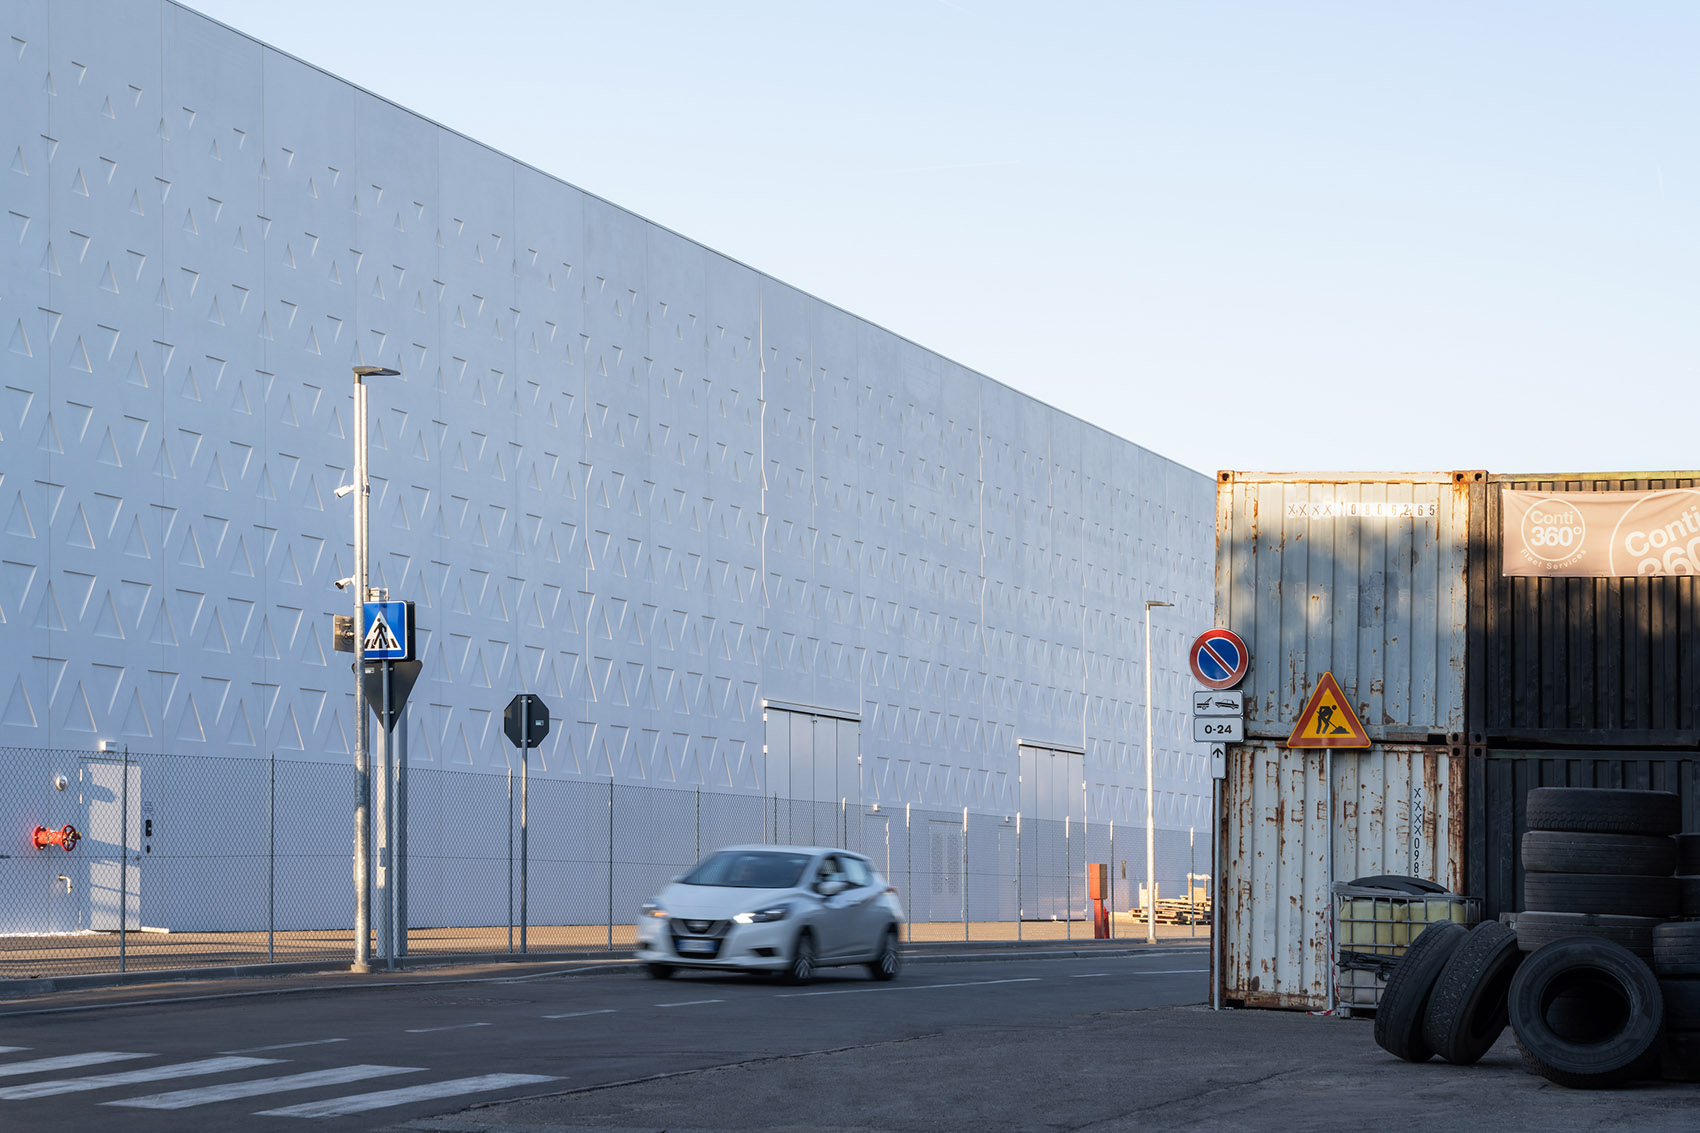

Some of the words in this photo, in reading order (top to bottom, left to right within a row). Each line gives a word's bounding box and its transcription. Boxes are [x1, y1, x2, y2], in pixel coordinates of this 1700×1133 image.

[1530, 510, 1574, 525] Conti
[1625, 505, 1700, 557] Conti
[1520, 548, 1542, 568] Fleet
[1546, 549, 1587, 570] Services
[1204, 724, 1233, 735] 0-24
